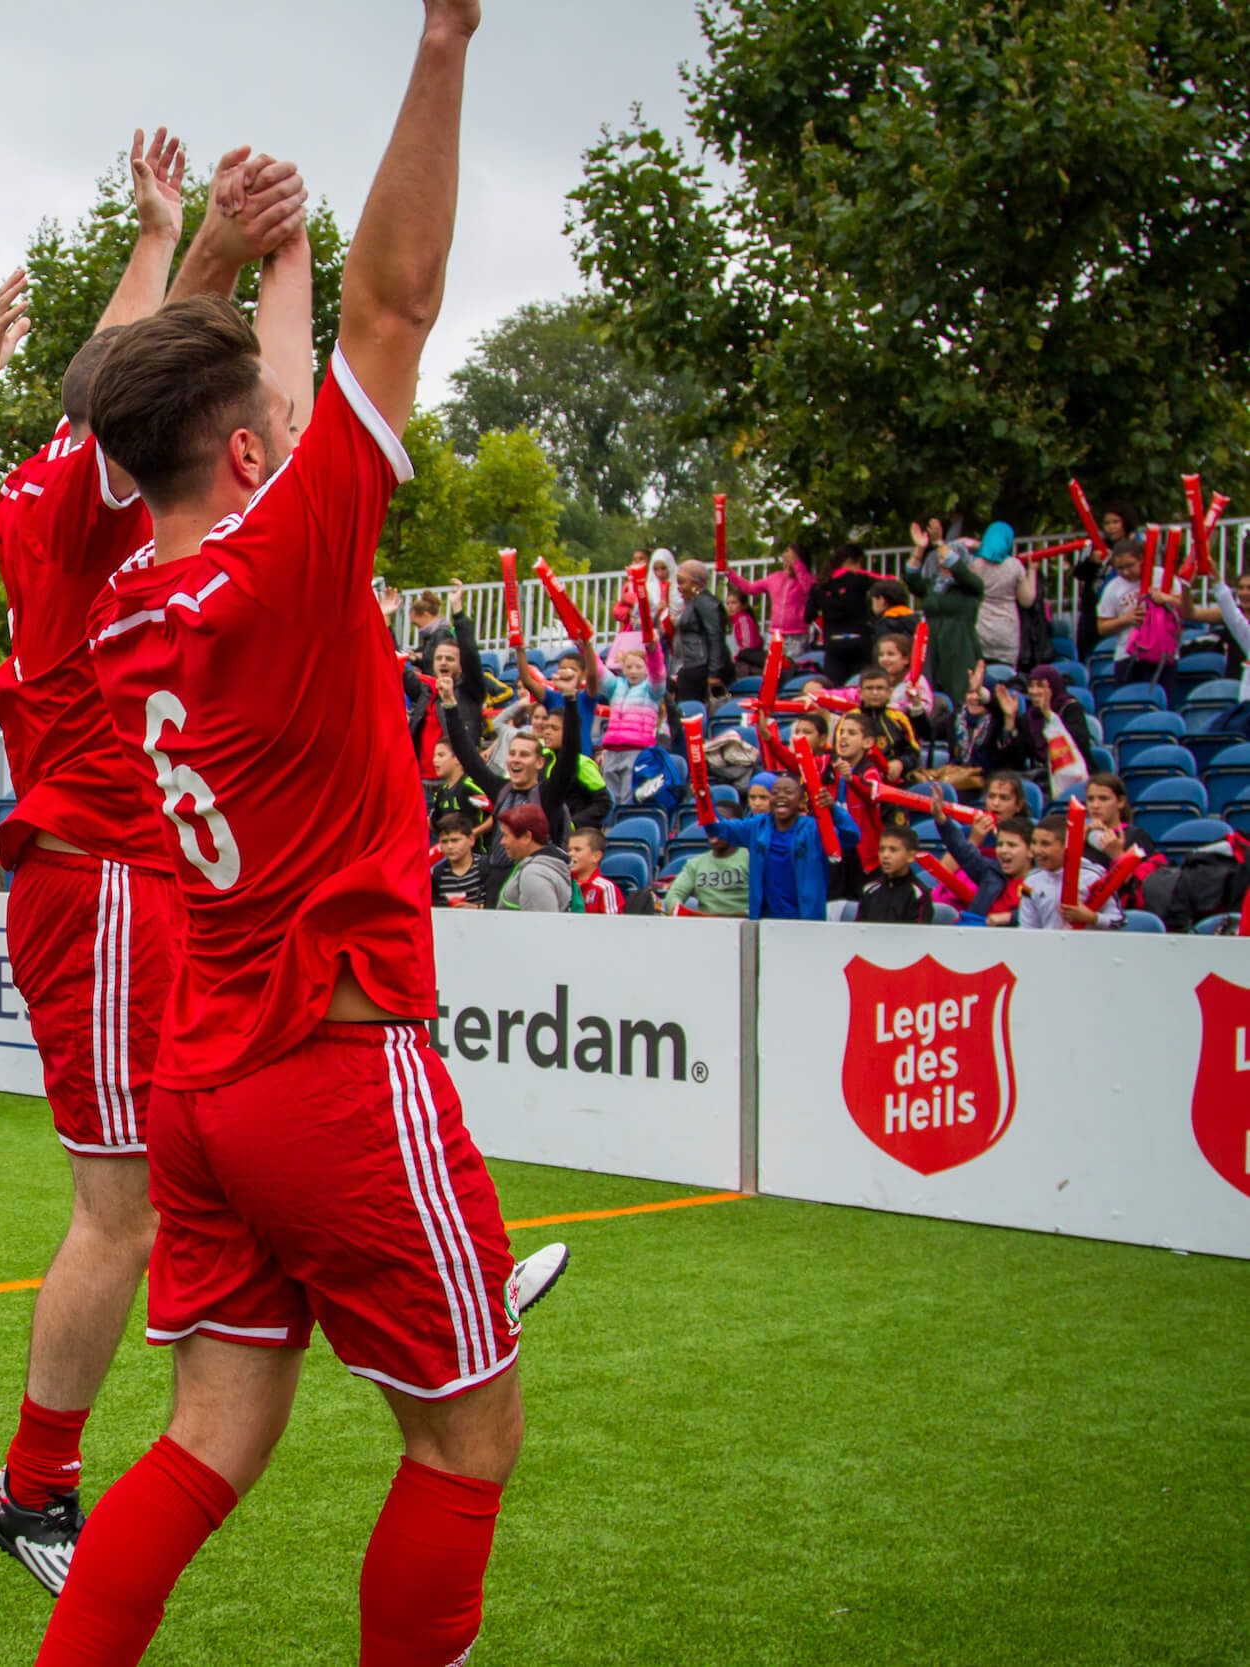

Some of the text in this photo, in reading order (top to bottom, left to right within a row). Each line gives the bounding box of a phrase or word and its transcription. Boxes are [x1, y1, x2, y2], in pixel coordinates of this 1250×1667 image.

[143, 690, 241, 890] 6
[697, 868, 744, 888] 3301
[876, 994, 979, 1044] Leger
[894, 1044, 959, 1086] des
[884, 1085, 977, 1134] Heils
